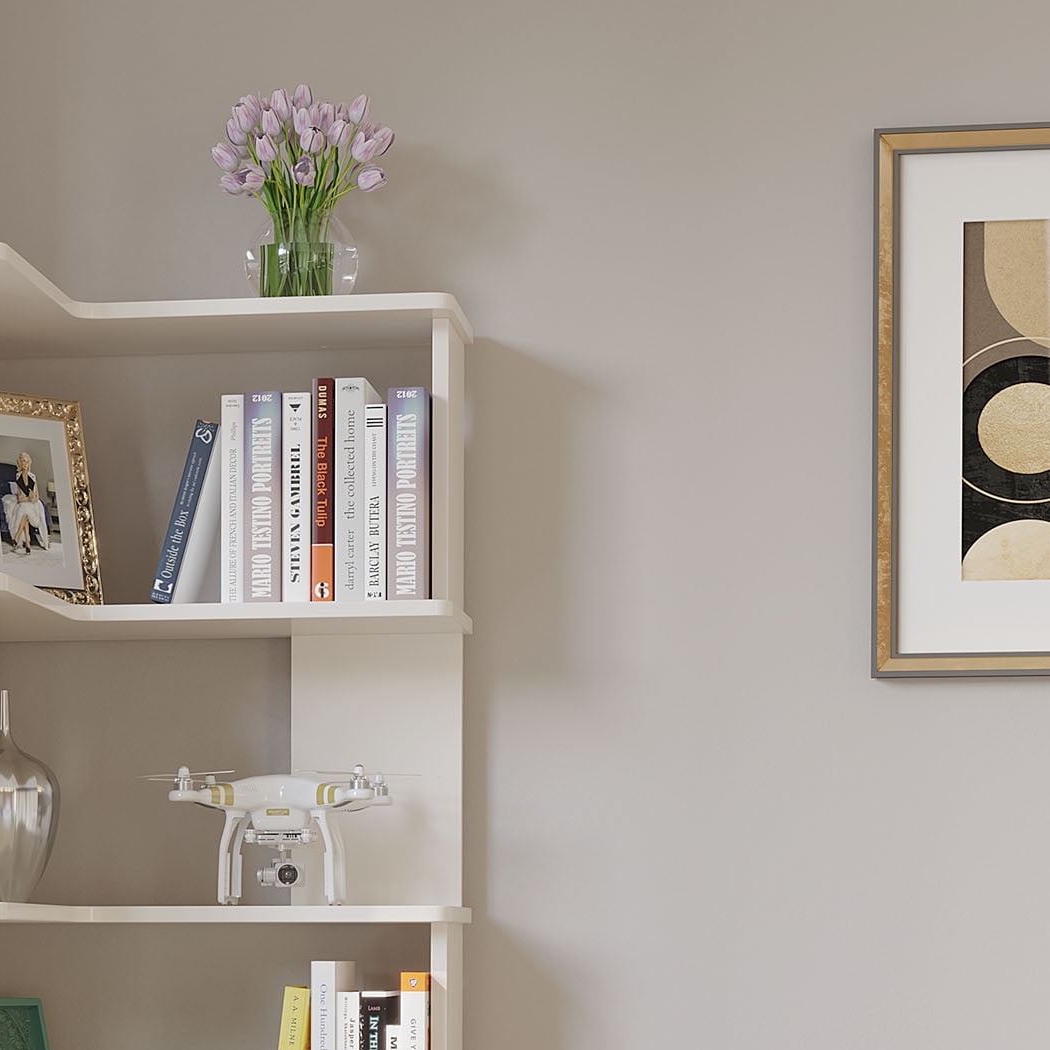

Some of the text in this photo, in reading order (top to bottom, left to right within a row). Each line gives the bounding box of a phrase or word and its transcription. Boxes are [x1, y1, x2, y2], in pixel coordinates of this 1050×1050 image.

[252, 394, 272, 402] 2012
[318, 385, 327, 418] DUMAS
[397, 390, 417, 398] 2012
[344, 410, 355, 520] the collected home
[229, 473, 237, 502] ITALIAN
[316, 436, 327, 528] The Black Tulip
[174, 509, 189, 527] Box
[229, 503, 237, 518] AND
[251, 496, 272, 550] TESTINO
[290, 443, 301, 583] STEVEN GAMBREL
[369, 495, 380, 536] BUTERA
[396, 493, 417, 548] TESTINO
[170, 528, 184, 544] the
[229, 519, 237, 548] FRENCH
[160, 545, 179, 579] Outside
[229, 548, 237, 559] OF
[344, 529, 357, 591] darryl carter
[369, 542, 380, 587] BARCLAY
[229, 559, 237, 586] ALLURE
[251, 554, 272, 598] MARIO
[396, 551, 417, 596] MARIO
[319, 984, 328, 1005] One
[289, 1017, 297, 1046] MILNE
[348, 1018, 357, 1048] Jasper
[369, 1015, 379, 1028] IN
[409, 1018, 417, 1041] GIVE
